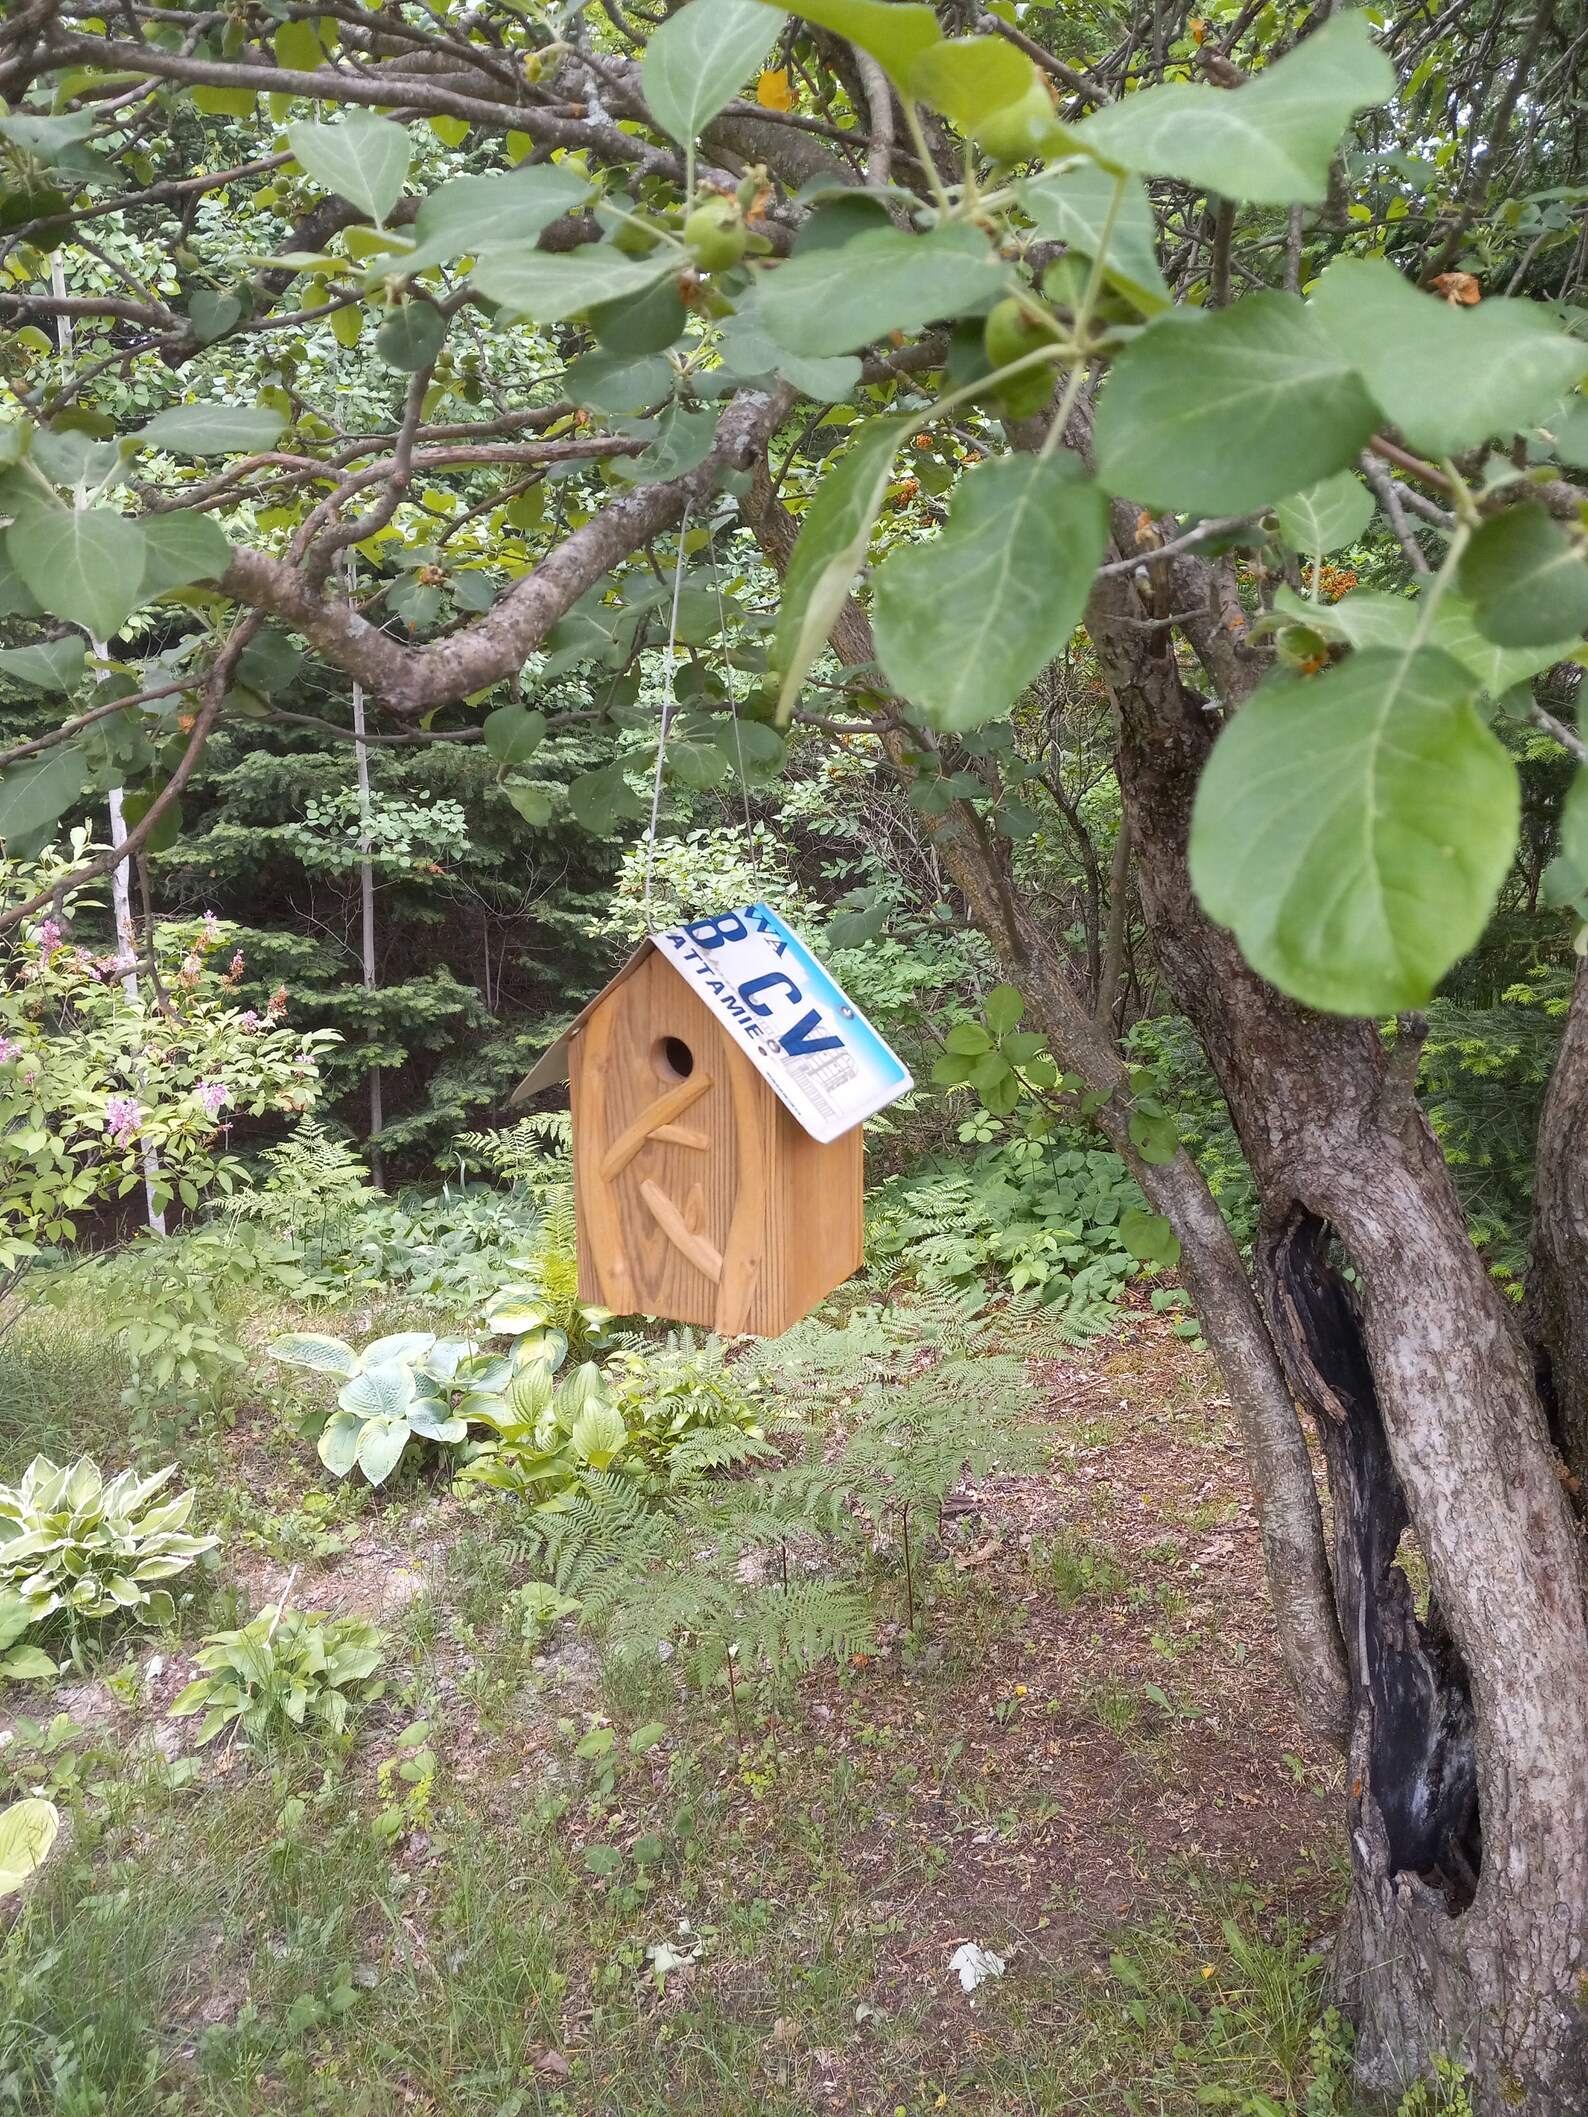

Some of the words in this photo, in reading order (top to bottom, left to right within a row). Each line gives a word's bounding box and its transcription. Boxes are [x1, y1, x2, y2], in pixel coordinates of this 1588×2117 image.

[744, 906, 789, 959] WA
[666, 935, 764, 1040] ATTAMIE
[738, 972, 846, 1057] CV
